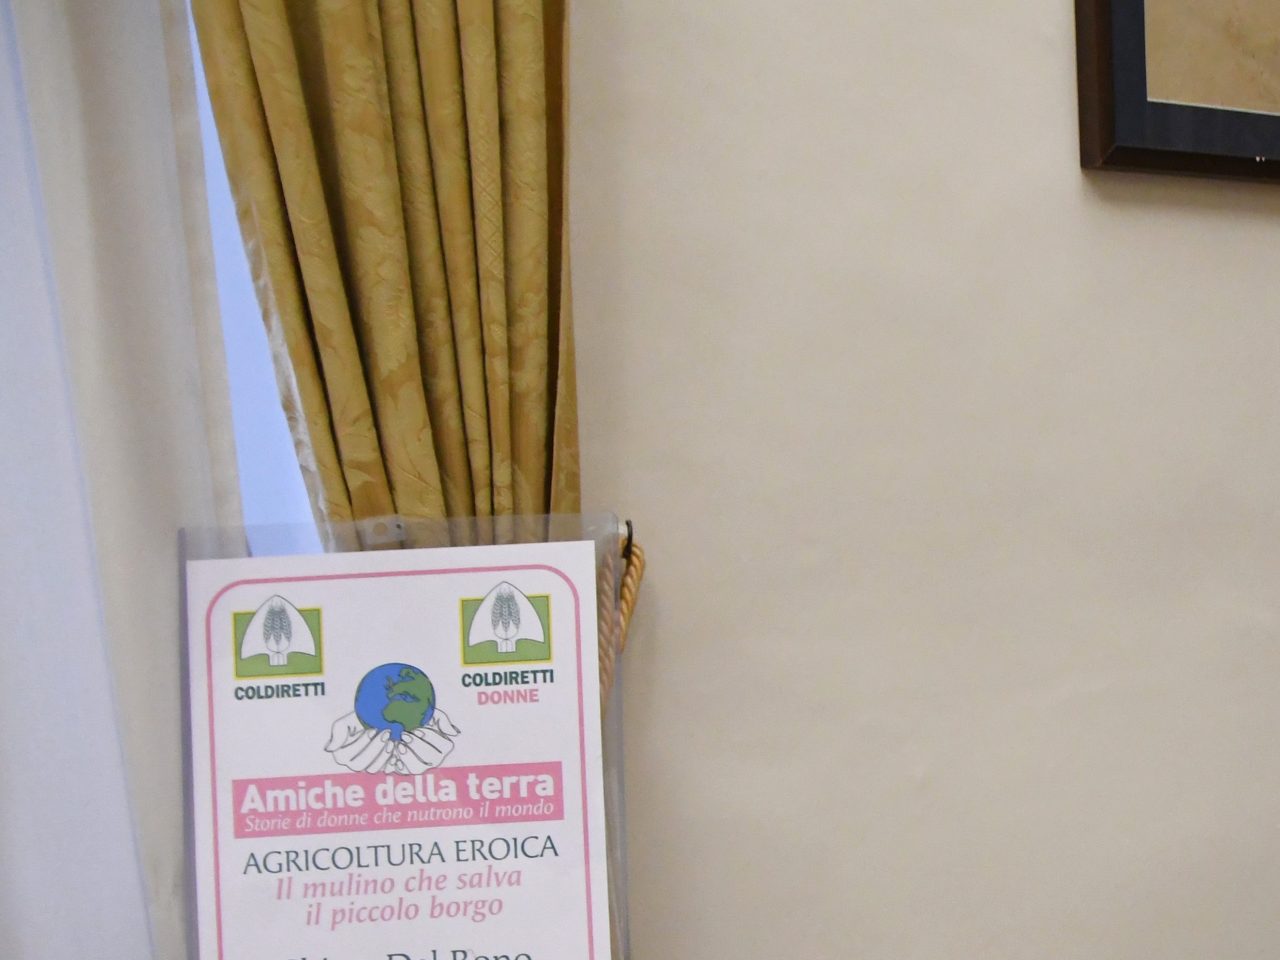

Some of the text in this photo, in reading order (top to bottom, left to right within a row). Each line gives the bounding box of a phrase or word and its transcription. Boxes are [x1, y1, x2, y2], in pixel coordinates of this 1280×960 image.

[234, 682, 326, 701] COLDIRETTI
[461, 668, 555, 689] COLDIRETTI
[477, 688, 540, 706] DONNE
[240, 772, 555, 814] Amiche della terra
[244, 798, 555, 833] Storie di donne che nutrono il mondo
[243, 835, 559, 875] AGRICOLTURA EROICA
[275, 865, 523, 900] Il mulino che salva
[305, 896, 504, 931] il piccolo borgo
